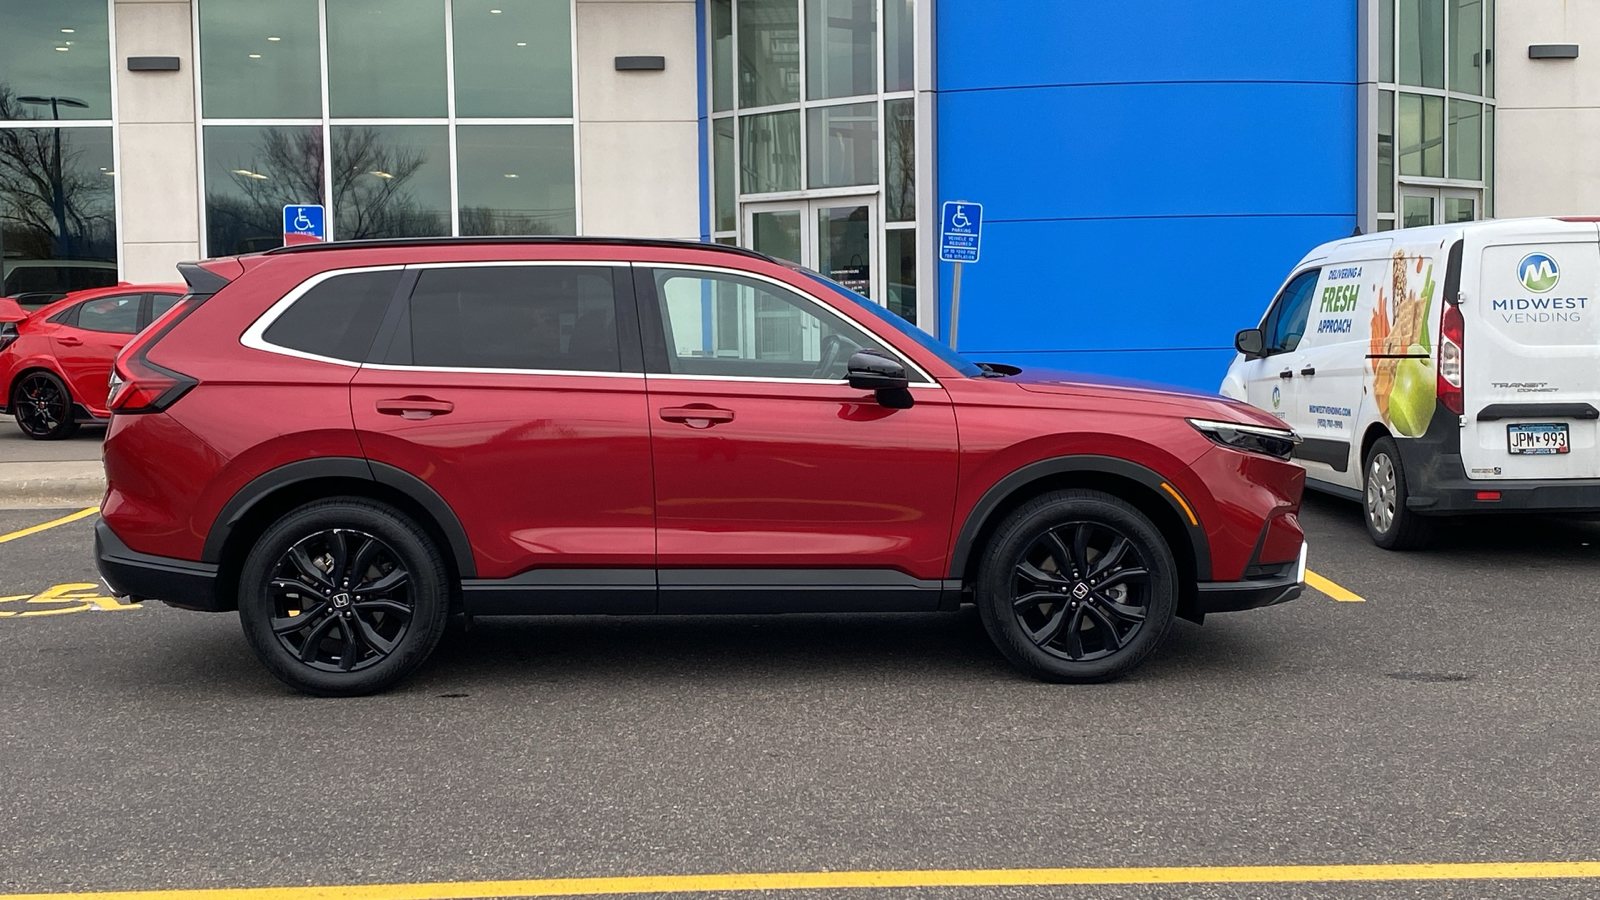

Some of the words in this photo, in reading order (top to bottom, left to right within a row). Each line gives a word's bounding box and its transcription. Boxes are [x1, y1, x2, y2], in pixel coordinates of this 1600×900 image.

[1328, 267, 1358, 280] DELIVERING
[1356, 266, 1362, 278] A
[1320, 284, 1360, 313] FRESH
[1492, 297, 1588, 311] MIDWEST
[1501, 312, 1581, 324] VENDING
[1317, 318, 1352, 334] APPROACH
[1309, 404, 1351, 416] MIDWESTVENDING.COM
[1512, 432, 1535, 447] JPM
[1543, 432, 1566, 447] 993
